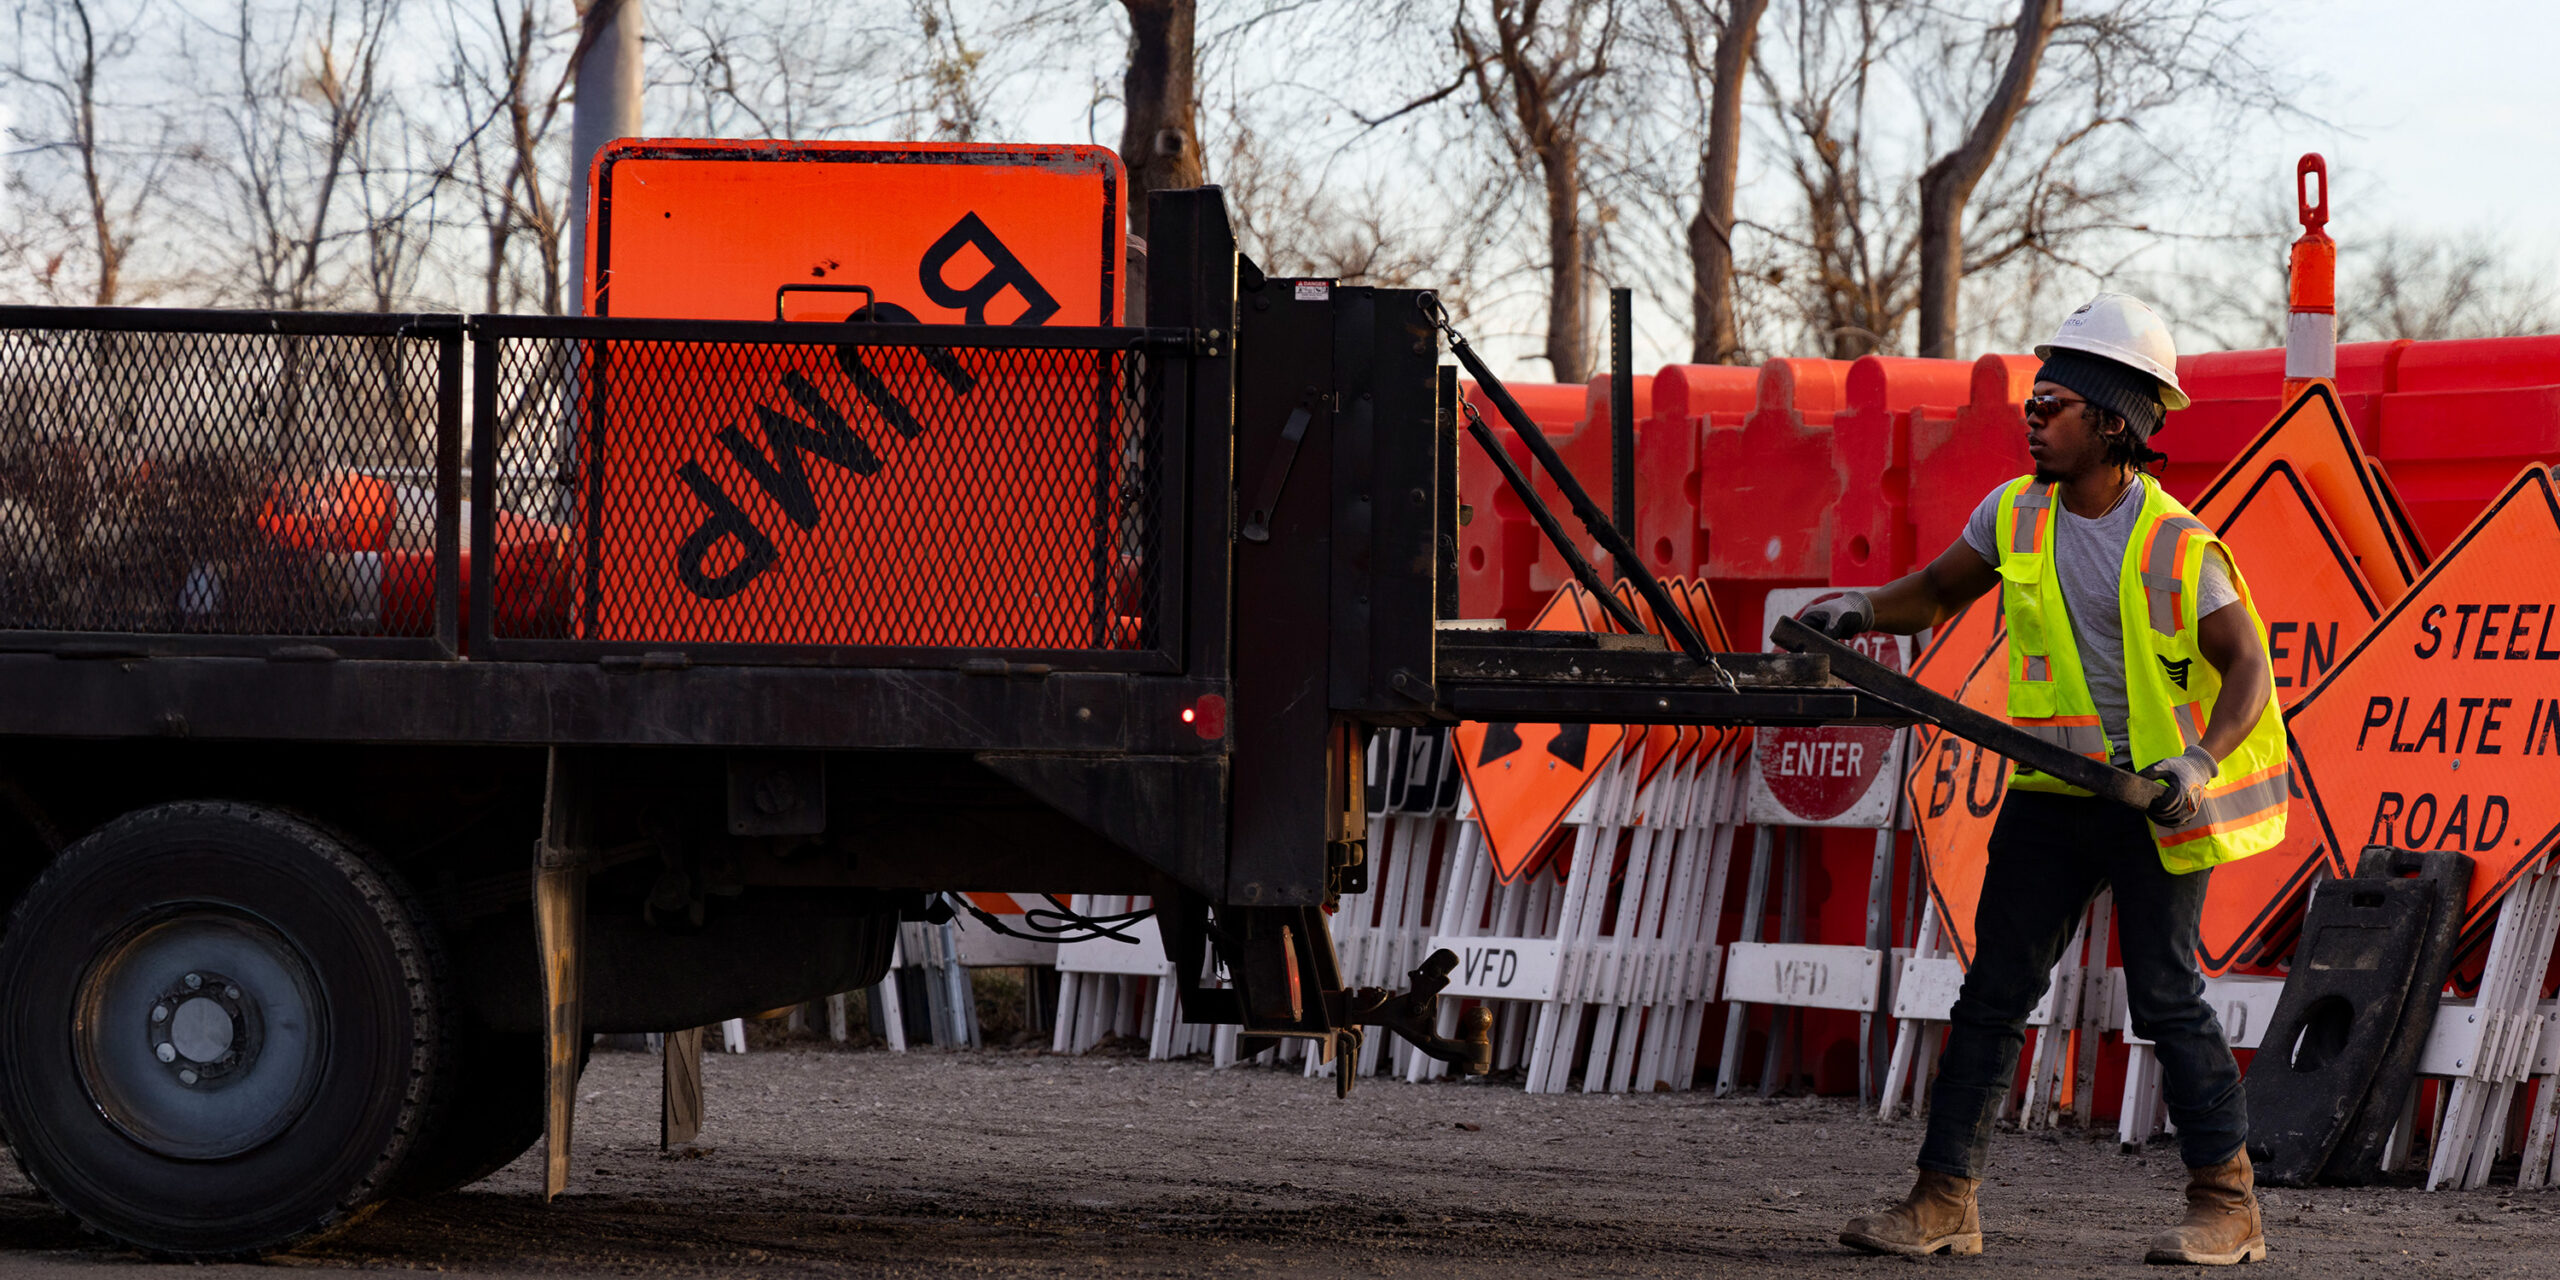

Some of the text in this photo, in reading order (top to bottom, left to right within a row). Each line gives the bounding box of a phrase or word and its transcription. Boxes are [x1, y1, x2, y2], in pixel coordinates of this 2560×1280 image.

[677, 210, 1062, 600] BUMP
[2414, 603, 2560, 660] STEEL
[2356, 696, 2513, 755] PLATE
[1780, 741, 1864, 777] ENTER
[2368, 792, 2510, 852] ROAD
[1465, 947, 1517, 987] VFD
[1775, 960, 1829, 996] VFD
